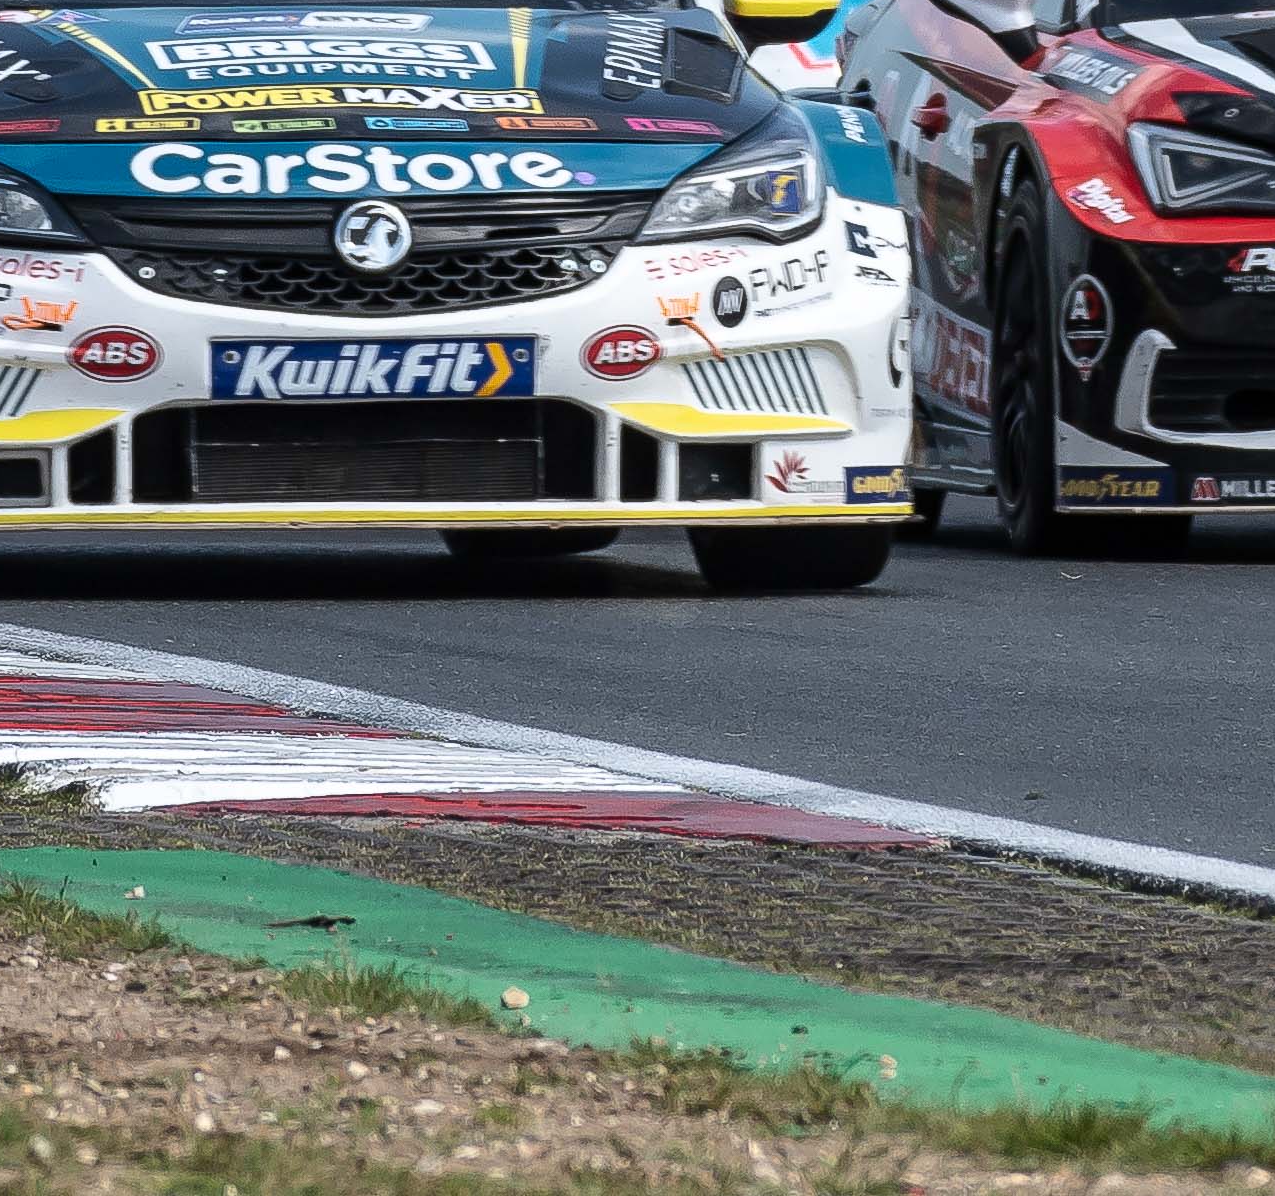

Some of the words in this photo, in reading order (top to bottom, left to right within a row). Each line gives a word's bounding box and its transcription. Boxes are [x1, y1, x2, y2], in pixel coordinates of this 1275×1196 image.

[172, 39, 471, 62] BRIGGS
[187, 62, 477, 81] EQUIPMENT
[152, 88, 337, 111] POWER
[342, 85, 533, 111] MAXED
[83, 341, 150, 366] ABS
[593, 339, 656, 365] ABS
[235, 342, 485, 400] KwikFit
